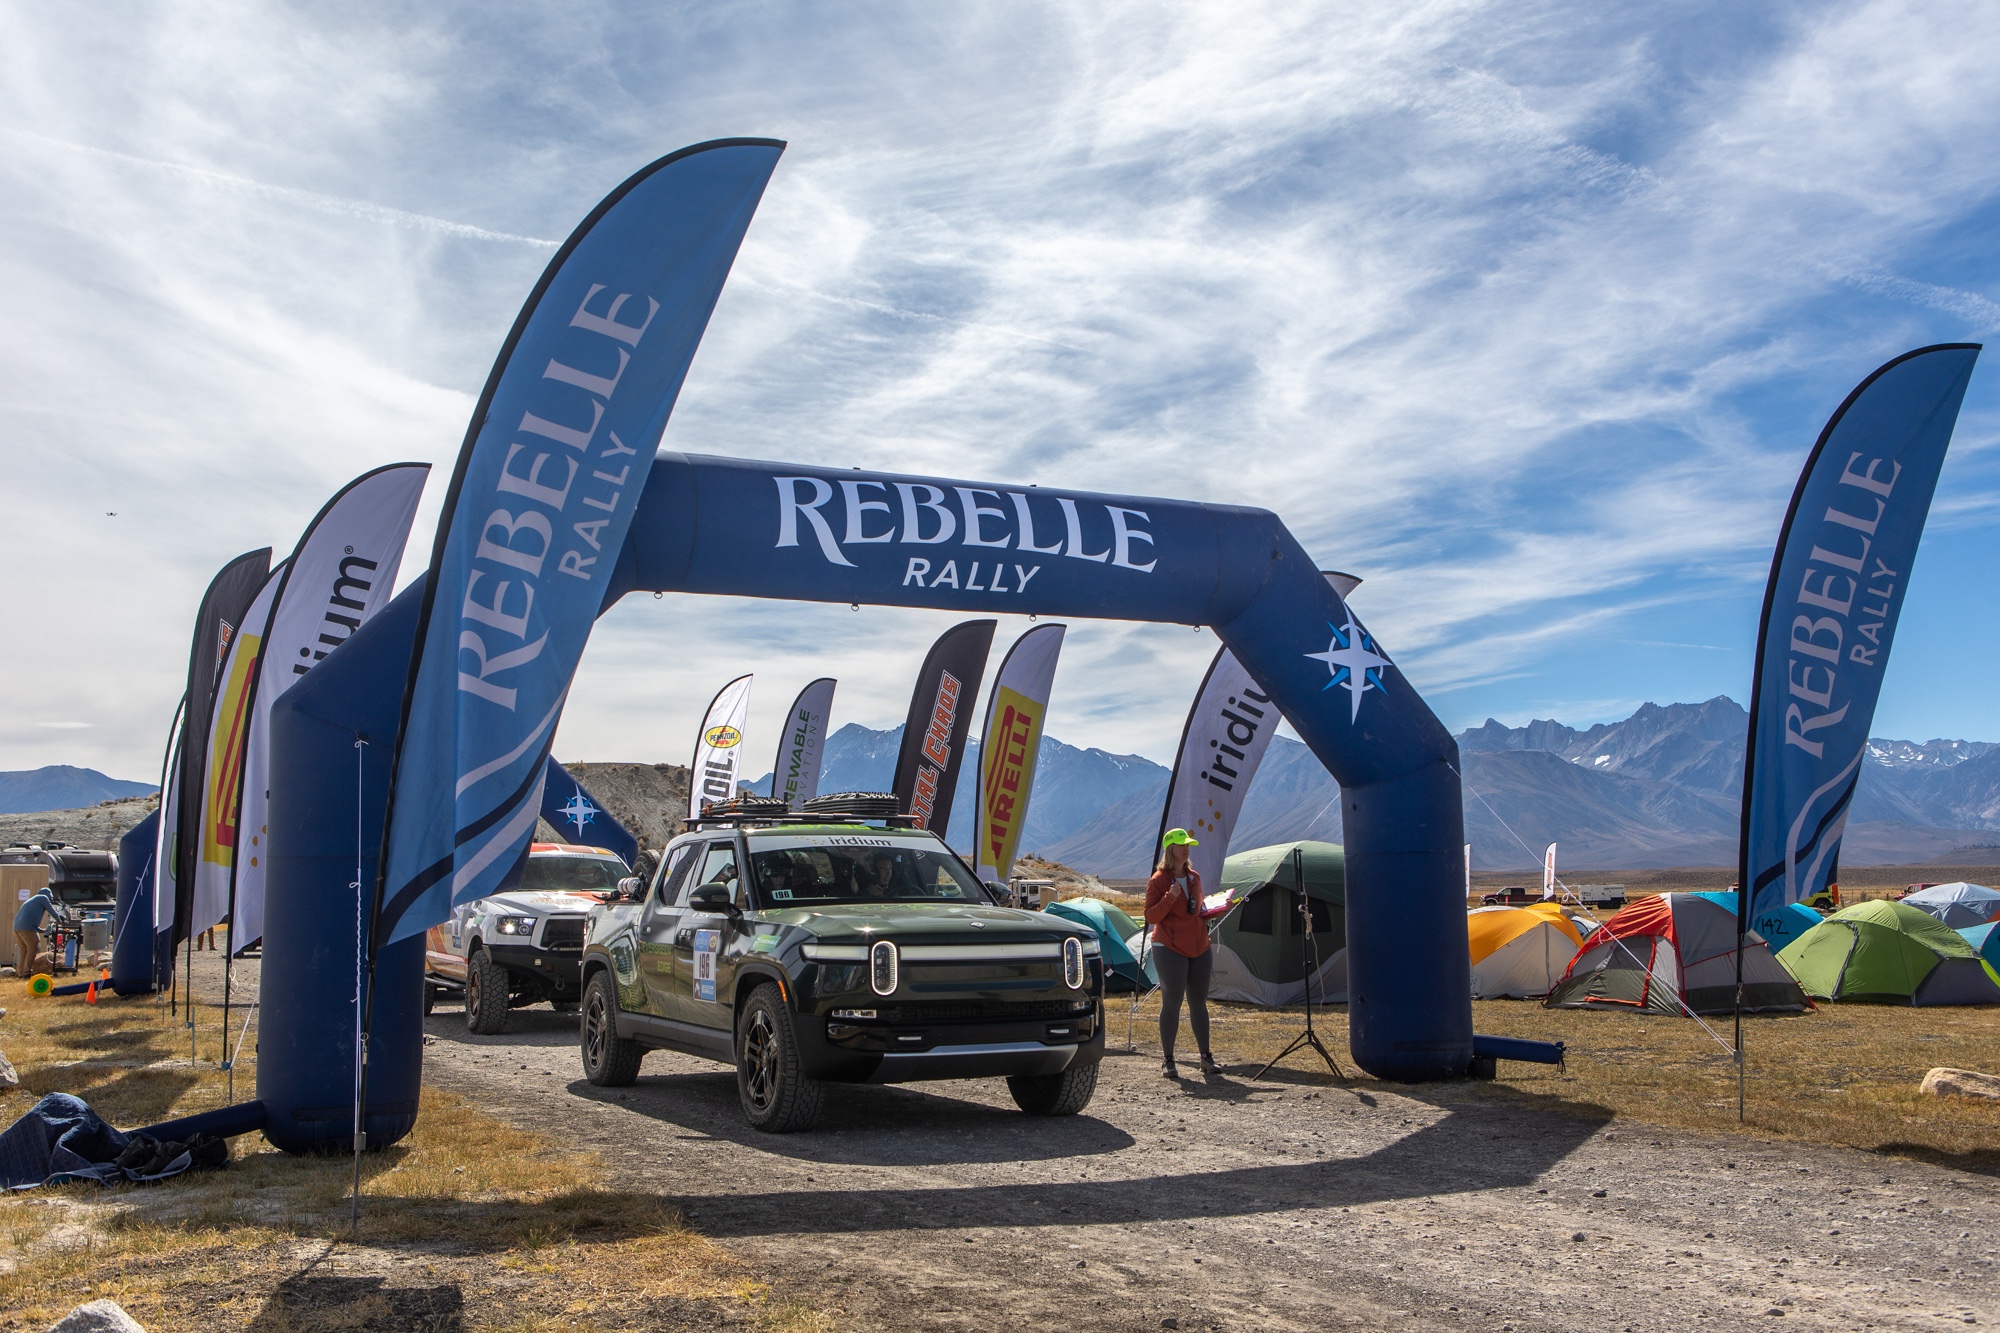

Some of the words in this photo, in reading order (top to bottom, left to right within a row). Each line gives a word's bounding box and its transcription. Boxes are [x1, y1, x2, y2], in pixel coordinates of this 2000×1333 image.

[458, 283, 660, 712] REBELLE
[557, 430, 637, 580] RALLY
[772, 476, 1158, 573] REBELLE
[902, 557, 1040, 594] RALLY
[1785, 451, 1902, 760] REBELLE
[1849, 557, 1897, 666] RALLY
[710, 732, 738, 742] PENNZOIL
[921, 669, 962, 771] CHAOS
[985, 705, 1031, 860] PIRELLI
[828, 836, 892, 847] iridium
[774, 891, 790, 899] 196
[1761, 918, 1789, 935] 142
[657, 960, 671, 973] EDGE
[699, 953, 710, 979] 196
